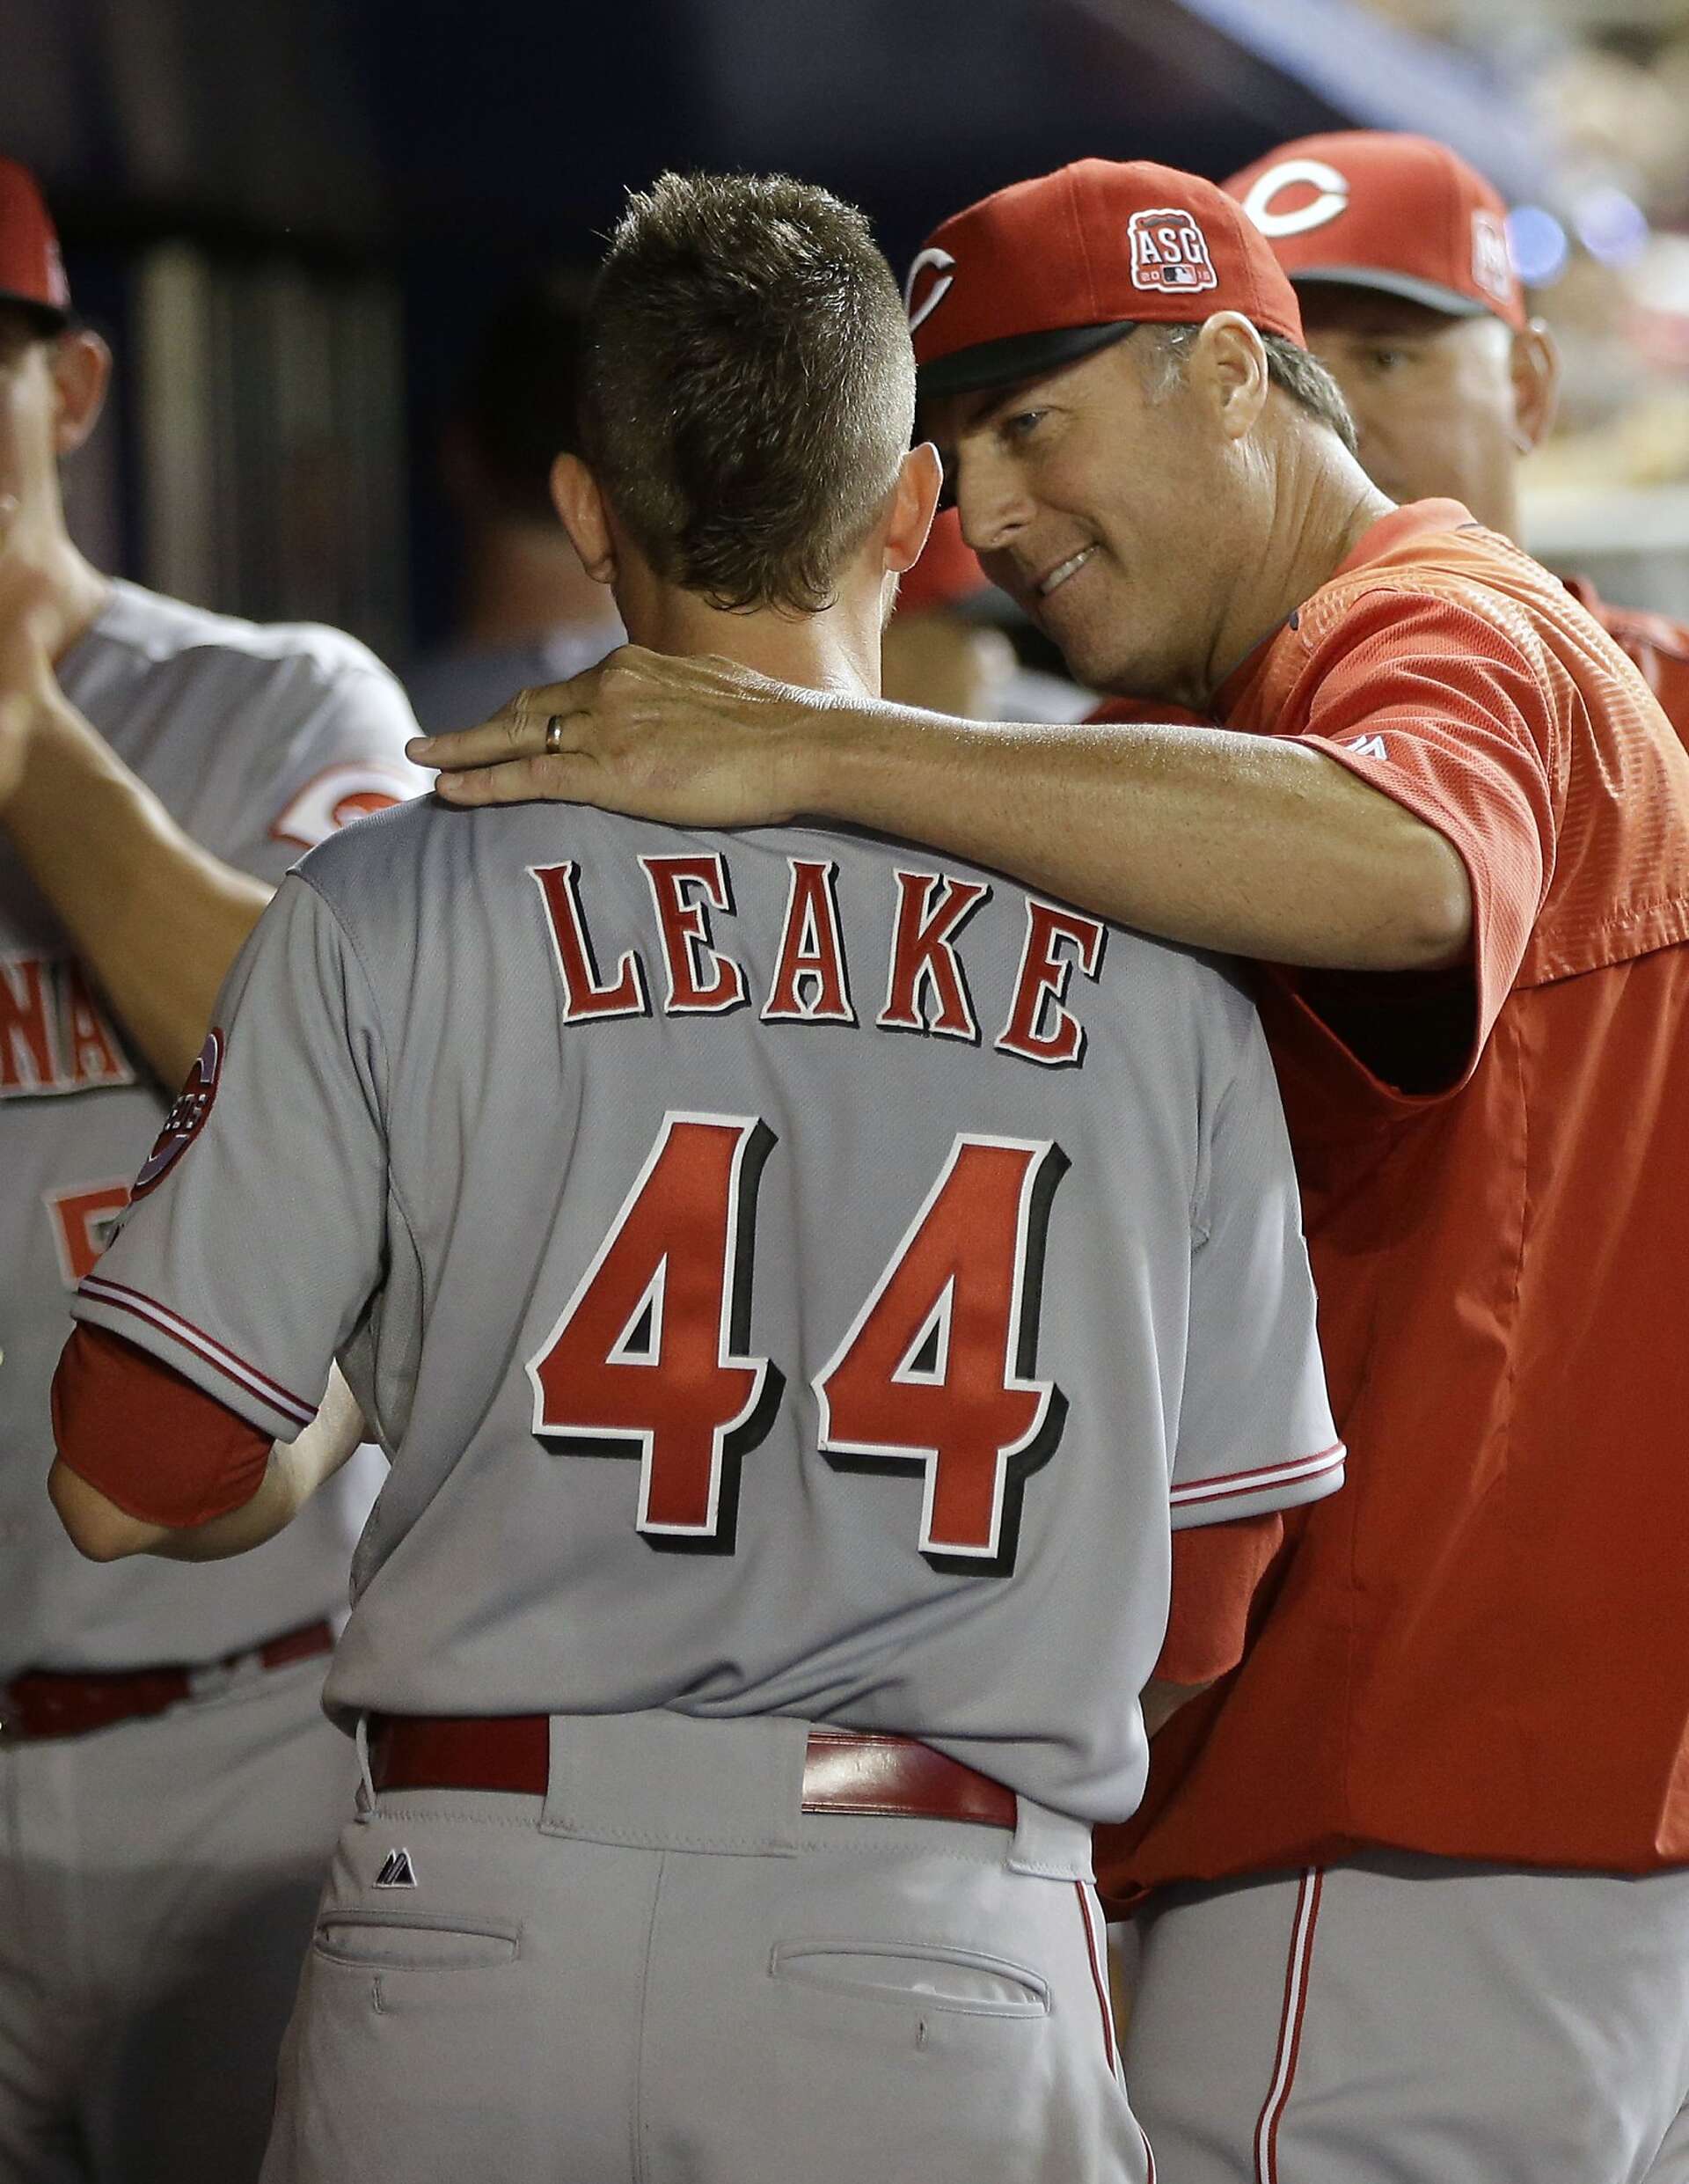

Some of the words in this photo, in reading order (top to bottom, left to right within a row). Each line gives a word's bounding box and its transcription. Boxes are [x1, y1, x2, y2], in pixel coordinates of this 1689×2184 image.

[1137, 228, 1204, 264] ASG
[1242, 159, 1350, 237] C
[527, 852, 1106, 1068] LEAKE
[525, 1110, 1072, 1579] 44
